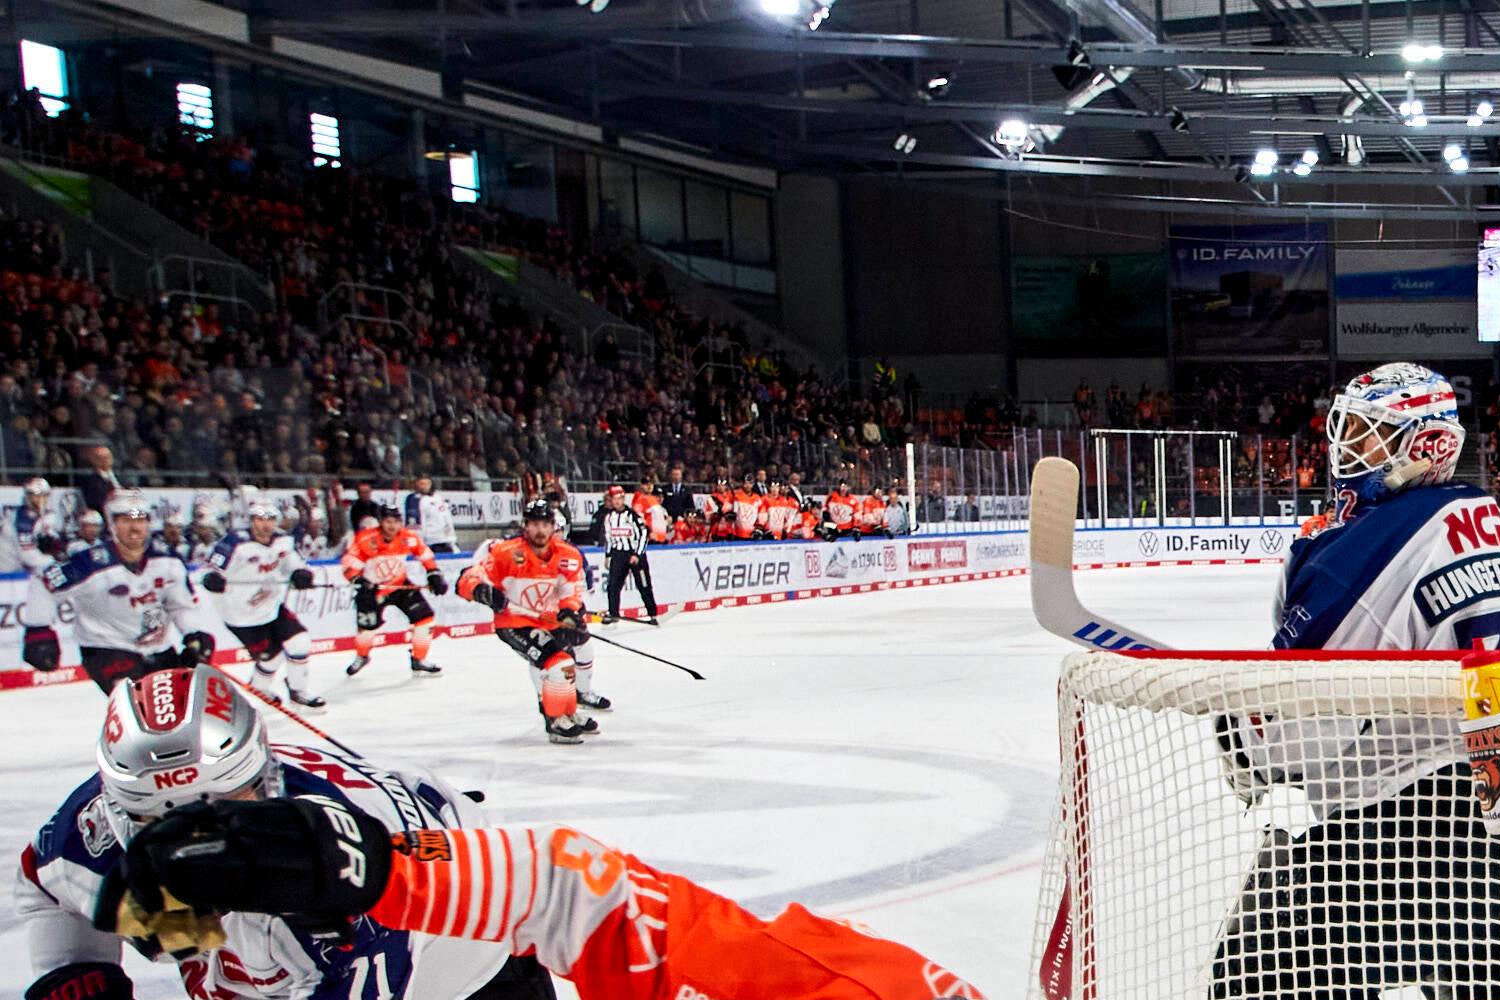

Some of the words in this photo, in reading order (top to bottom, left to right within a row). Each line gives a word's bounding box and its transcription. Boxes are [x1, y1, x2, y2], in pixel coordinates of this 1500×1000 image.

[1192, 246, 1315, 262] ID.FAMILY
[1342, 323, 1409, 338] Wolfsburger
[1412, 323, 1470, 338] Allgemeine
[1167, 534, 1250, 554] ID.Family
[715, 561, 790, 590] BAUER
[153, 766, 200, 790] NCP
[1053, 952, 1064, 969] in
[1049, 969, 1061, 995] 11x
